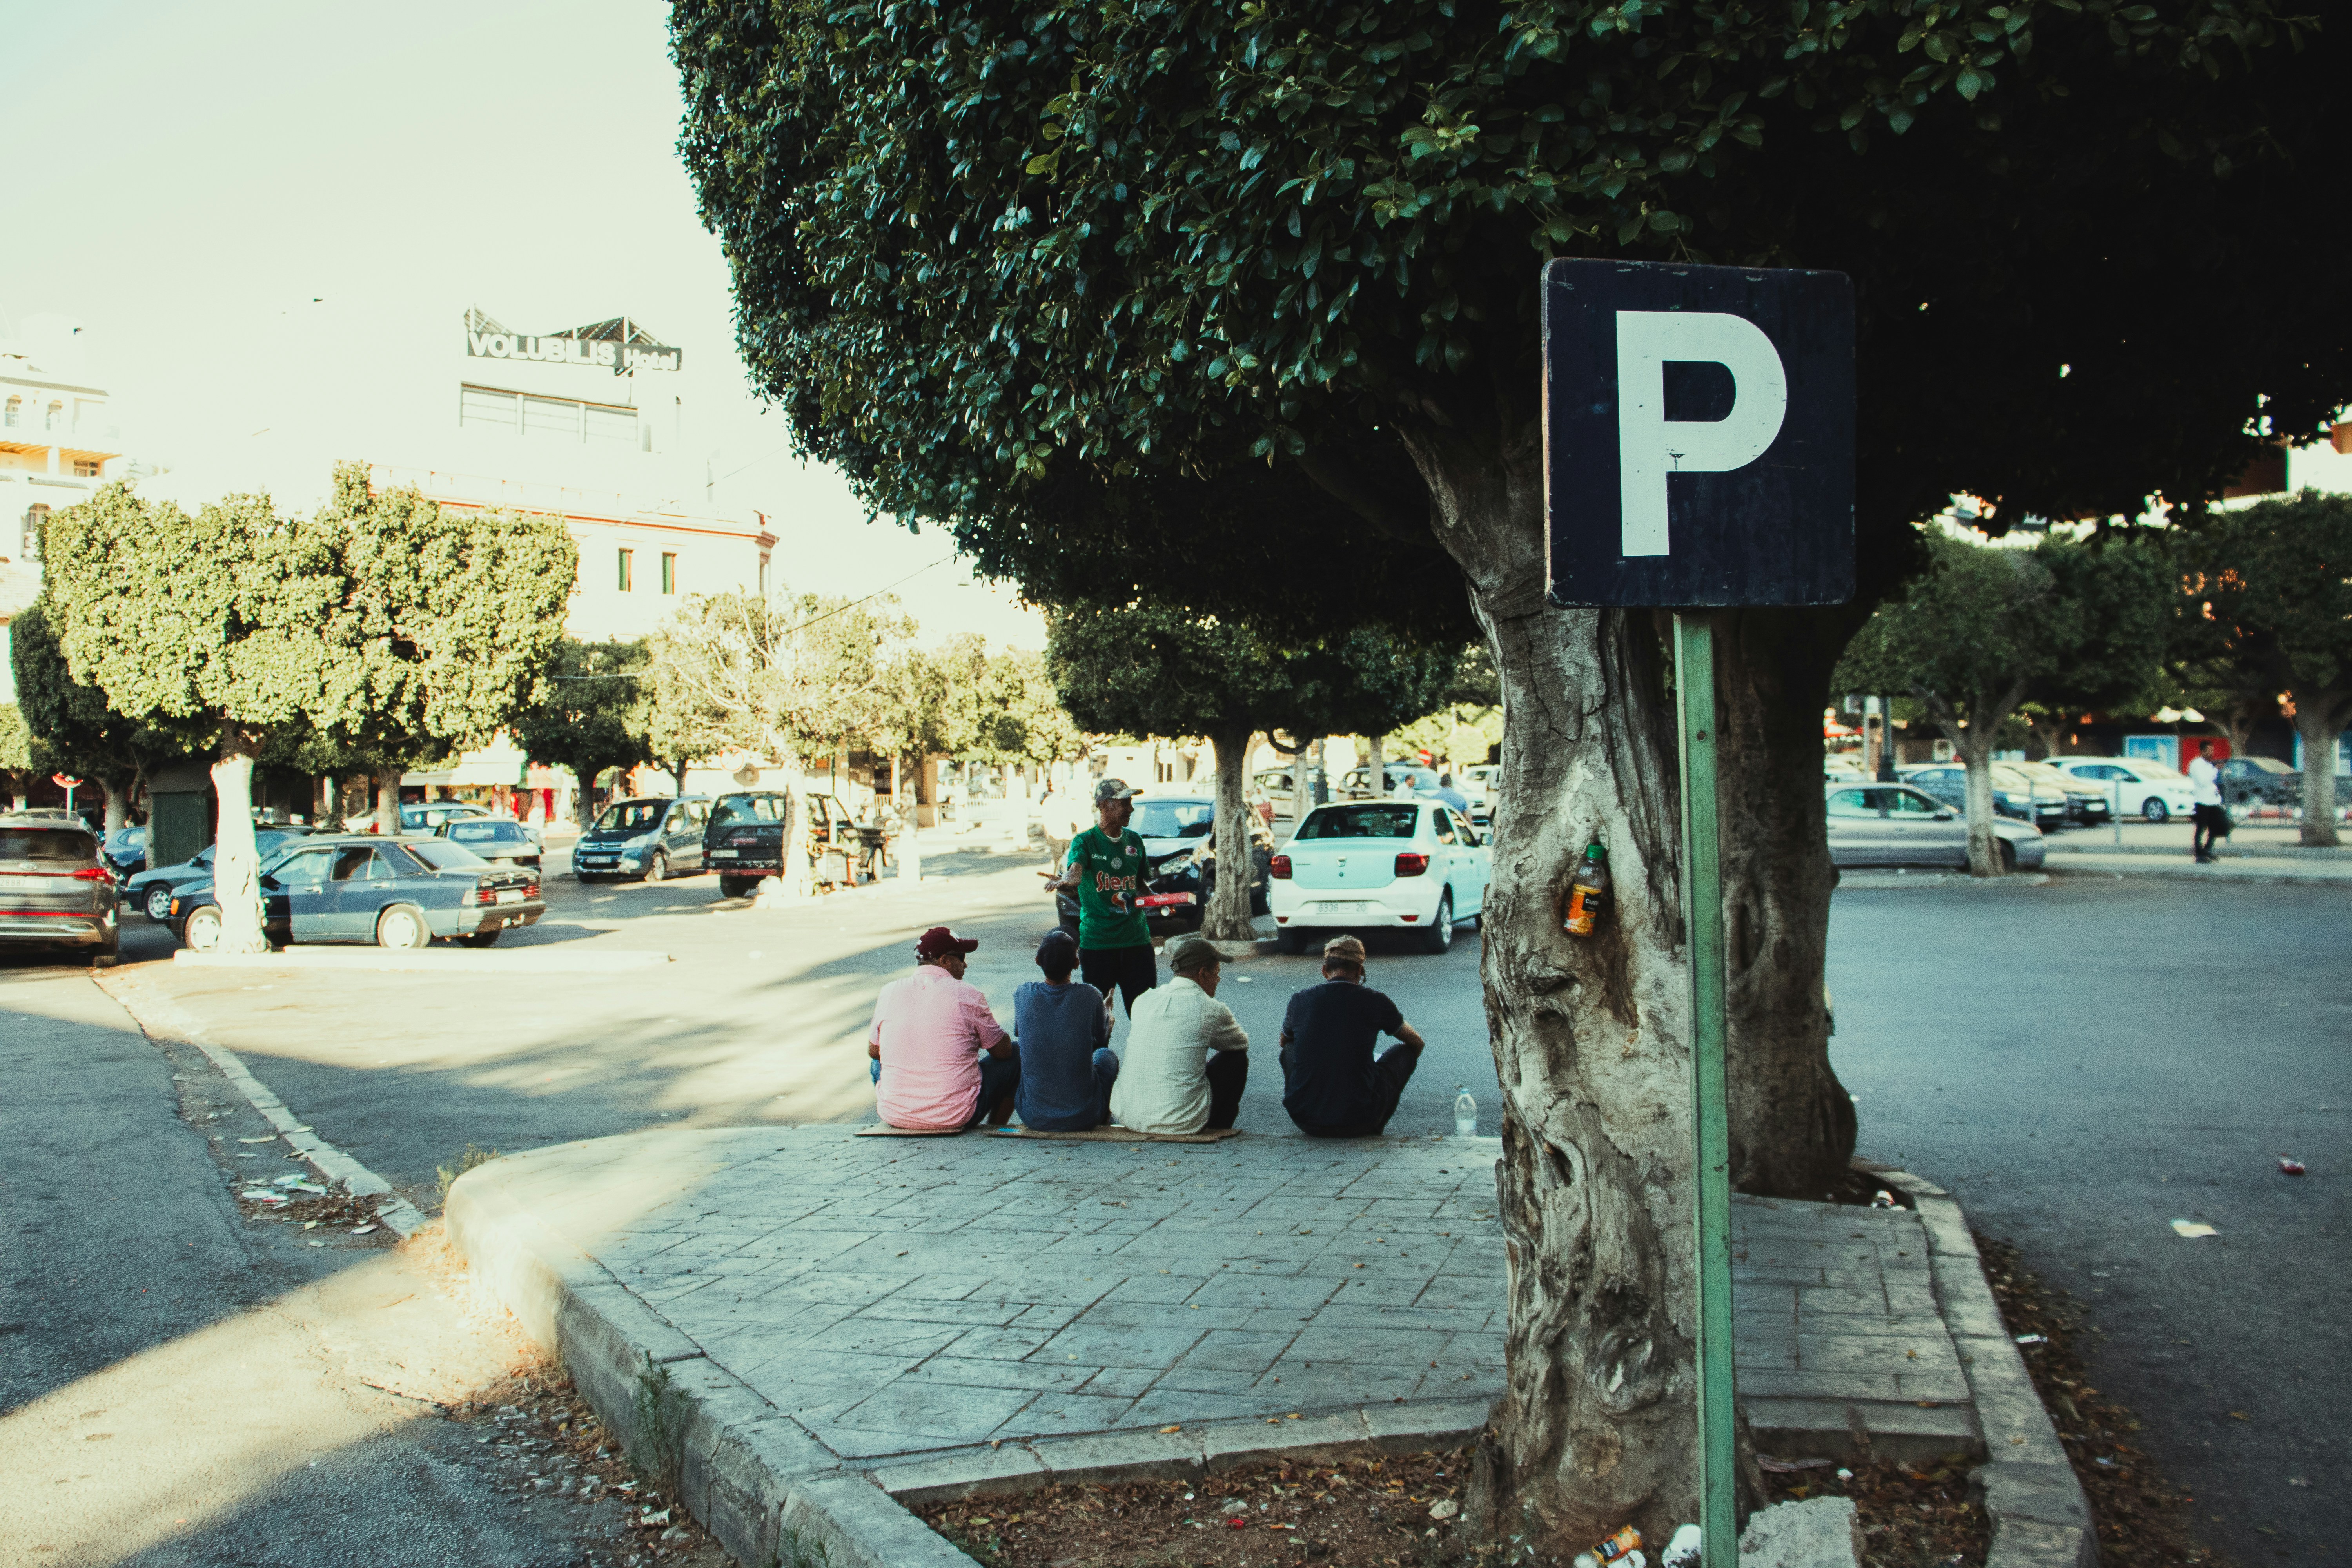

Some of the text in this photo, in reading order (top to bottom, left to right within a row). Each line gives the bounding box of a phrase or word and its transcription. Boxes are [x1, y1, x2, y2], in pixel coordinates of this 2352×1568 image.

[469, 332, 616, 366] VOLUBILIS
[1616, 311, 1787, 556] P
[1319, 904, 1338, 912] 6936
[1356, 904, 1366, 912] 20
